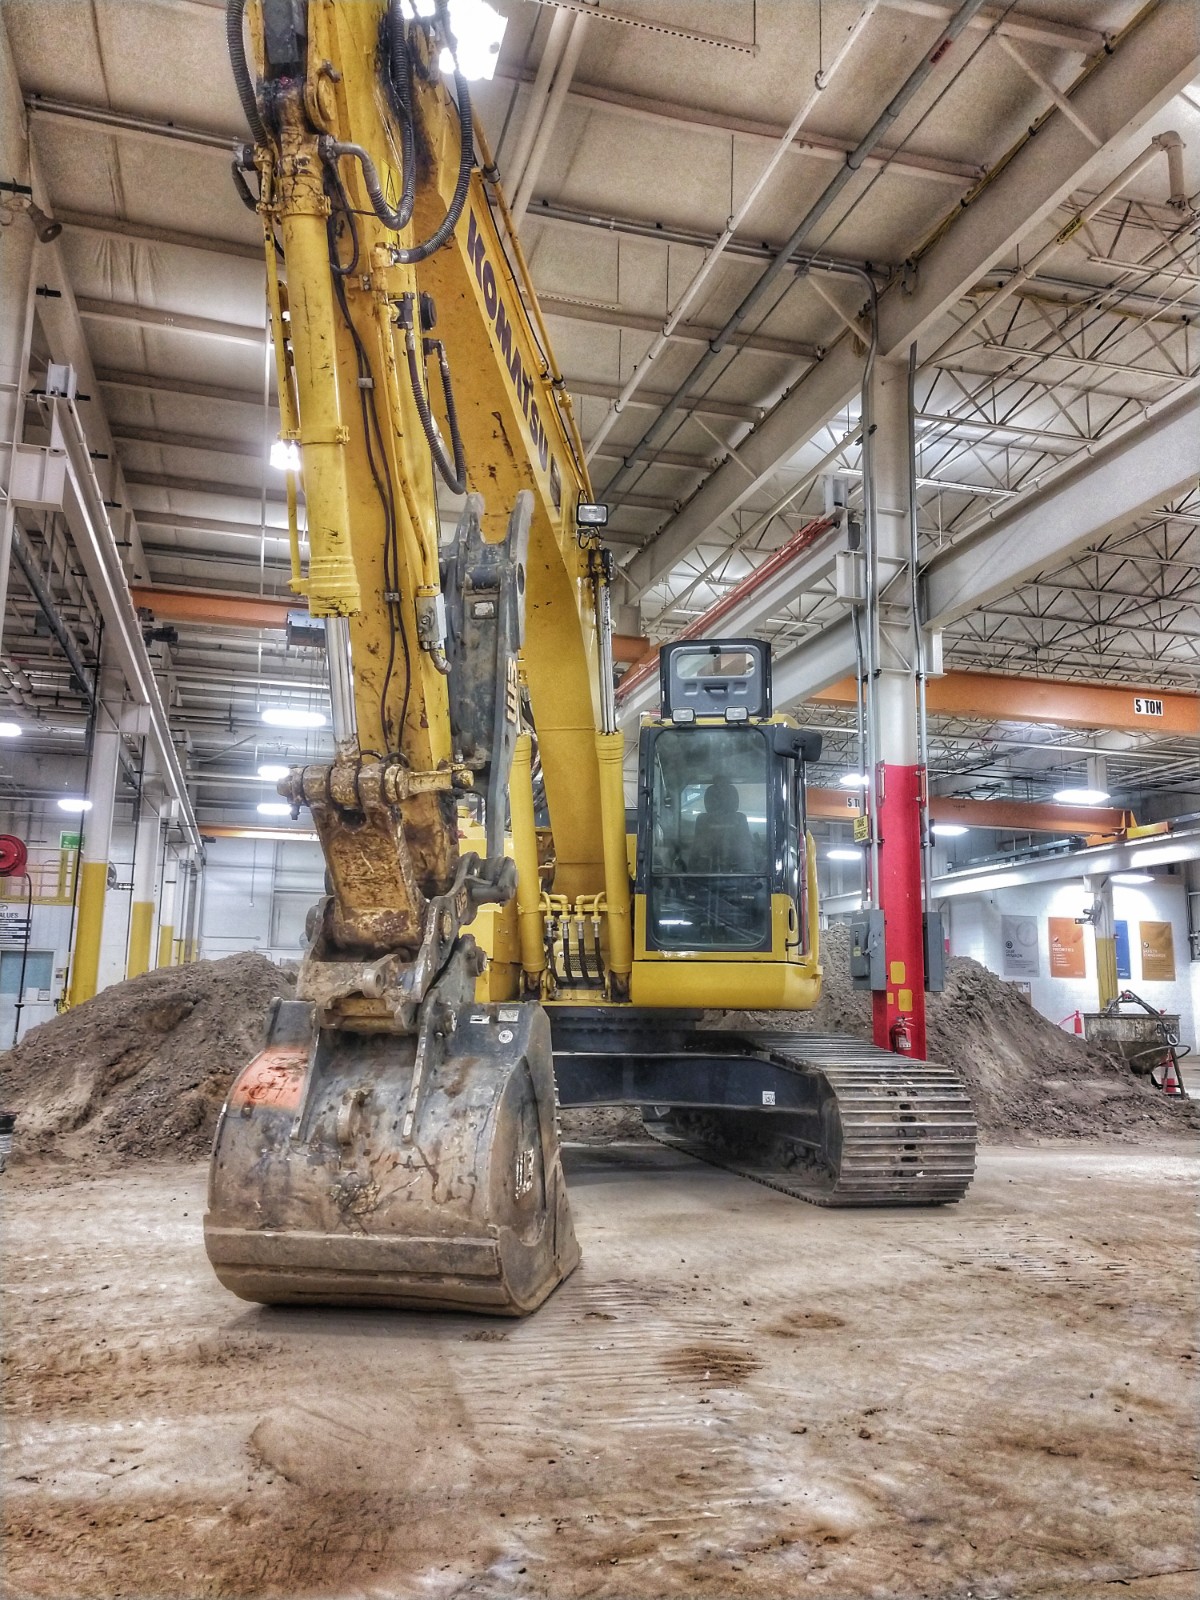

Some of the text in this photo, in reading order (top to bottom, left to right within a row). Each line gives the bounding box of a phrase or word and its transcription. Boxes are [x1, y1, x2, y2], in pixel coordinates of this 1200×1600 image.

[467, 206, 548, 472] KOMATSU
[1135, 698, 1162, 715] 5 TON
[847, 797, 853, 808] 5
